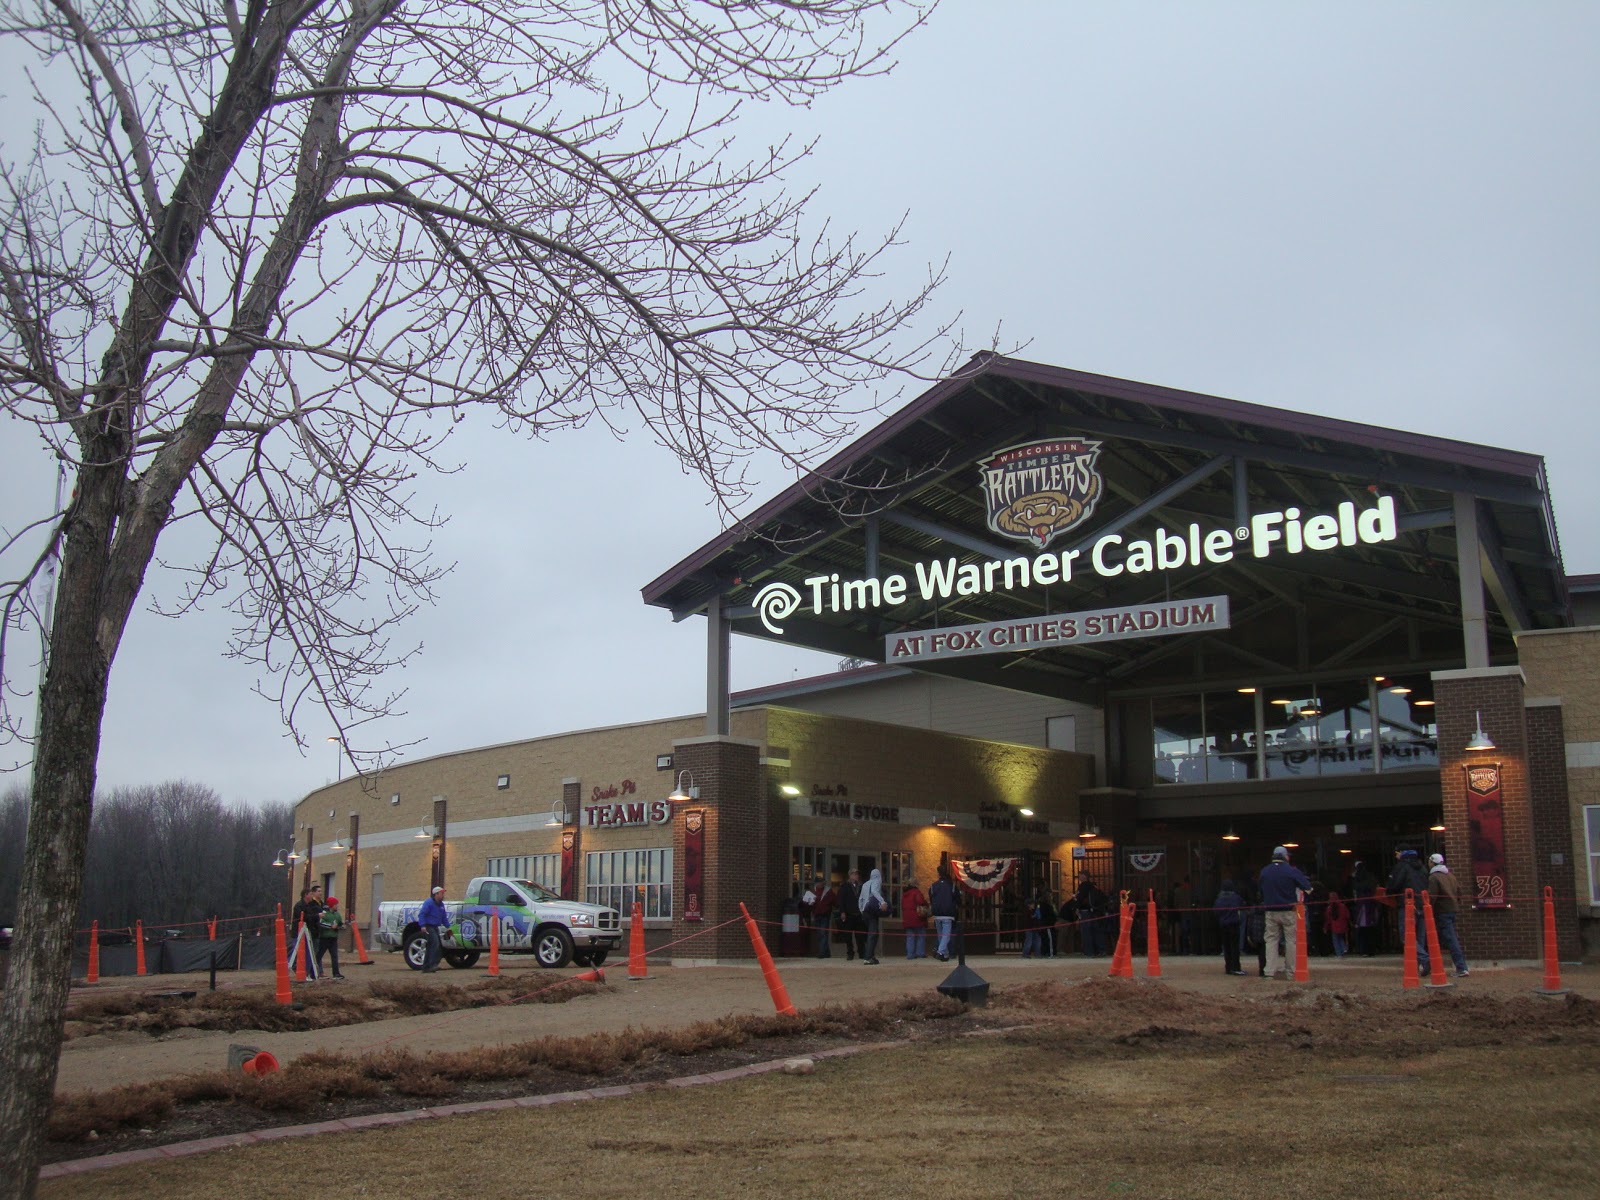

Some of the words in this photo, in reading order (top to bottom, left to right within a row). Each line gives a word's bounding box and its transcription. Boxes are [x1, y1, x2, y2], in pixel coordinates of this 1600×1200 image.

[1001, 444, 1077, 462] WISCONSIN
[1007, 453, 1071, 470] TIMBER
[987, 454, 1092, 510] RATTLERS
[804, 573, 907, 615] Time
[915, 549, 1081, 601] Warner
[1251, 495, 1397, 558] Field
[892, 626, 925, 657] AT
[931, 629, 983, 653] FOX
[988, 619, 1078, 646] CITIES
[1085, 603, 1216, 636] STADIUM
[585, 802, 646, 827] TEAM
[810, 800, 850, 818] TEAM
[853, 804, 899, 822] STORE
[1477, 875, 1504, 898] 32
[689, 893, 697, 912] 5
